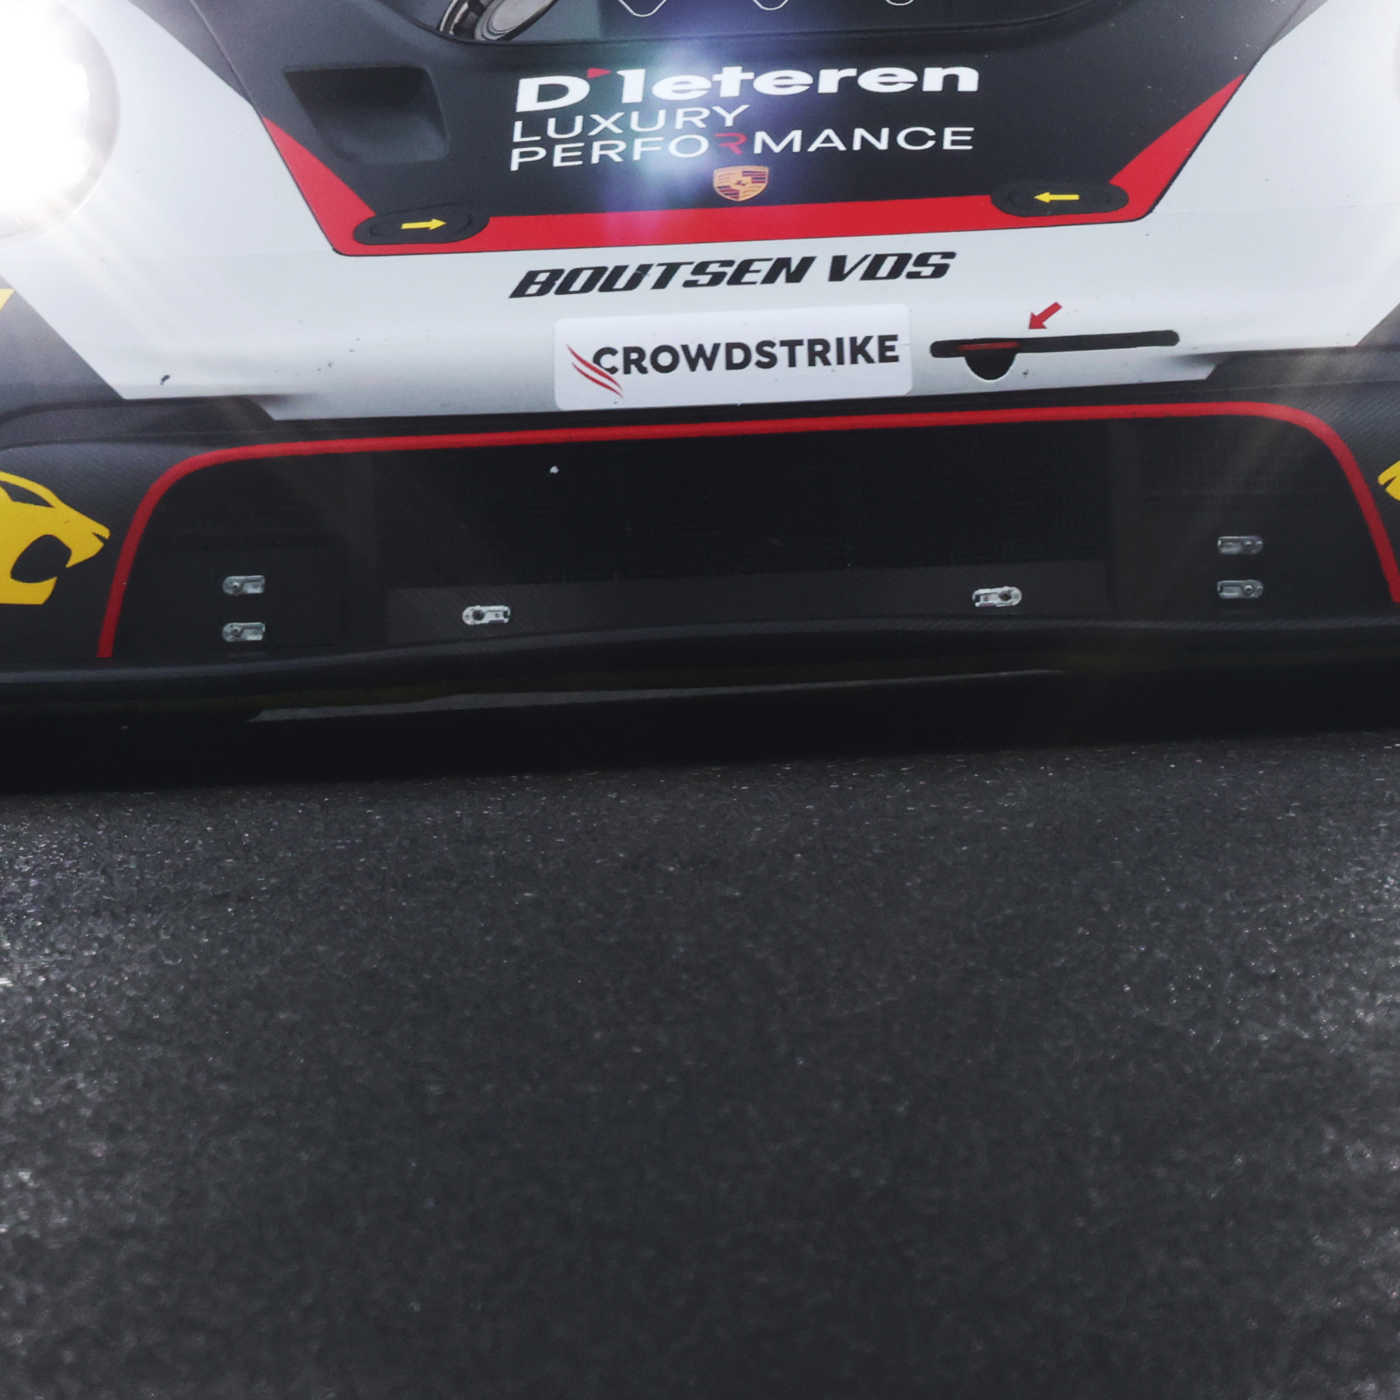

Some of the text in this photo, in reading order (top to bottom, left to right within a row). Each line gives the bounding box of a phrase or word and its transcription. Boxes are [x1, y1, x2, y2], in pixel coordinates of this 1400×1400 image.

[512, 104, 750, 143] LUXURY
[509, 126, 975, 172] PERFORMANCE
[508, 251, 957, 299] BOUTSEN VDS
[591, 333, 900, 376] CROWDSTRIKE
